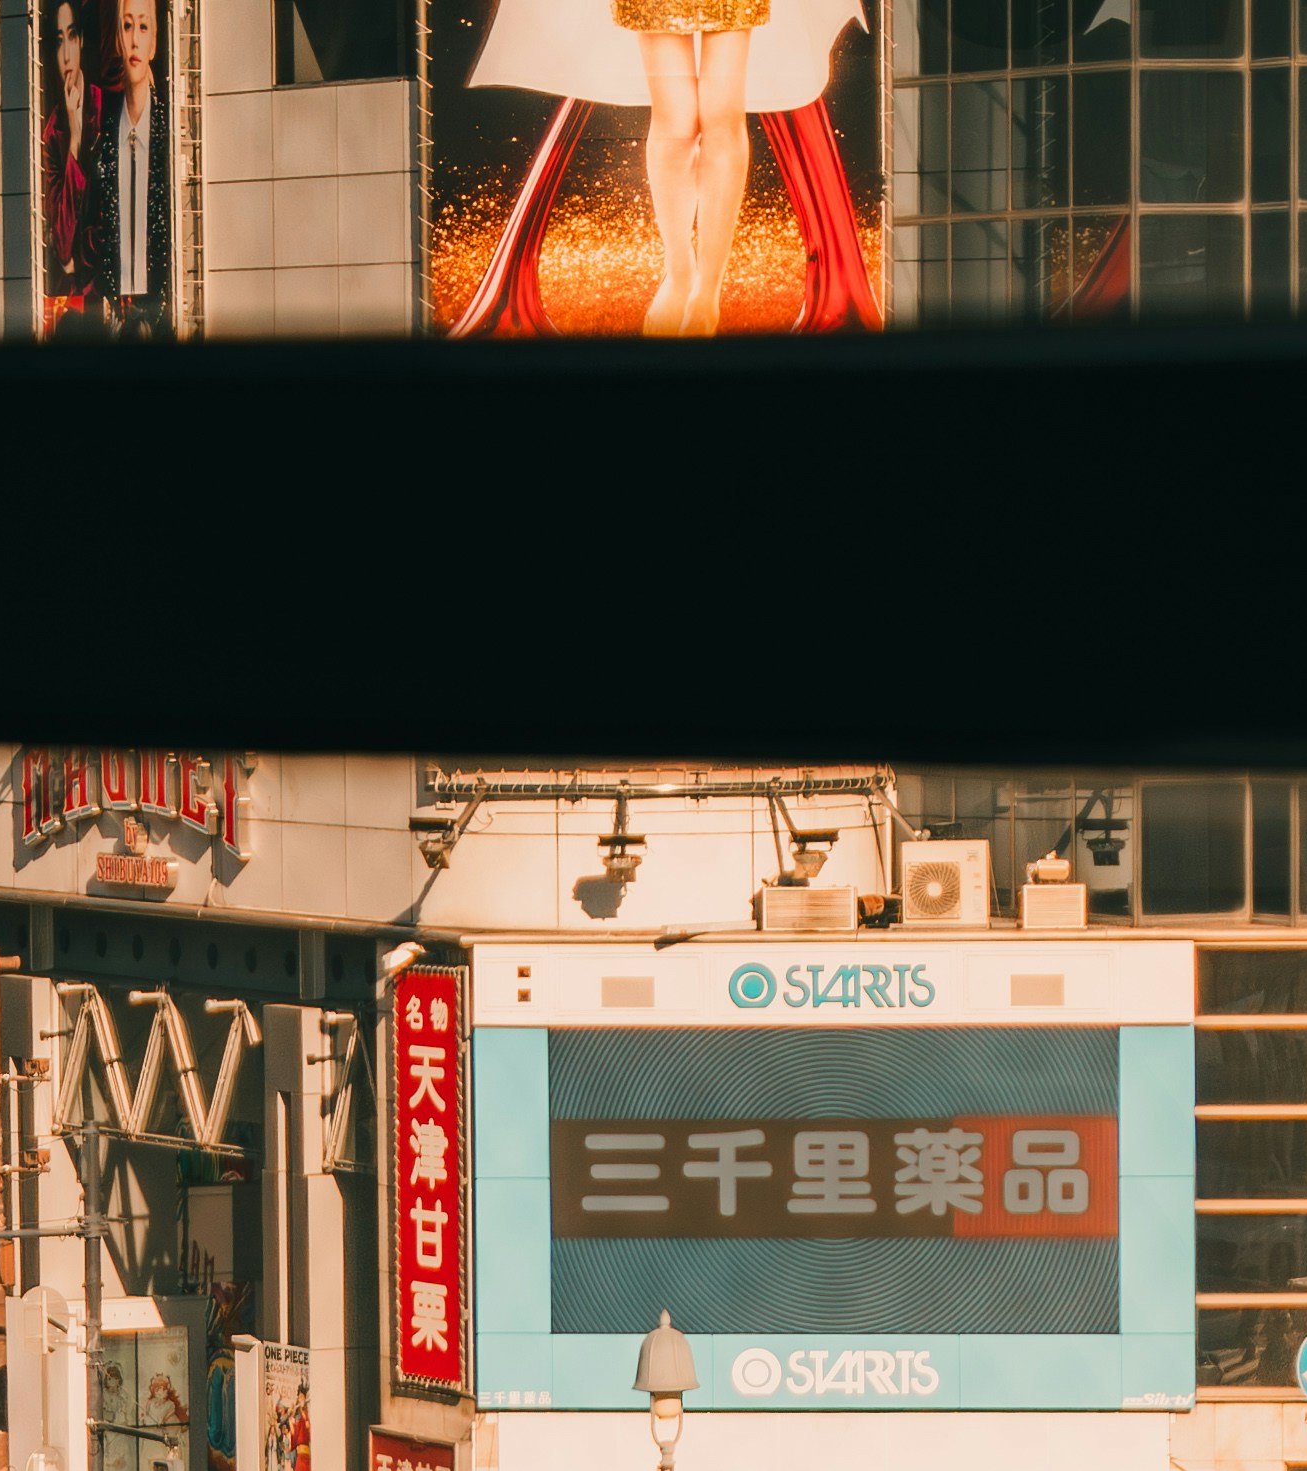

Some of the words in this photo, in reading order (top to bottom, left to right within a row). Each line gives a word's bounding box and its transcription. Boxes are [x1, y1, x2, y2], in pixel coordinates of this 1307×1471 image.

[96, 855, 169, 887] SHIBUYA109
[783, 964, 936, 1008] STARTS
[404, 995, 449, 1030] 名物
[580, 1128, 1090, 1217] 三千里薬品
[409, 1042, 450, 1353] 天津甘栗
[265, 1345, 282, 1360] ONE
[284, 1349, 309, 1365] PIECE
[786, 1349, 940, 1395] STARTS
[480, 1391, 552, 1405] 三千里薬品
